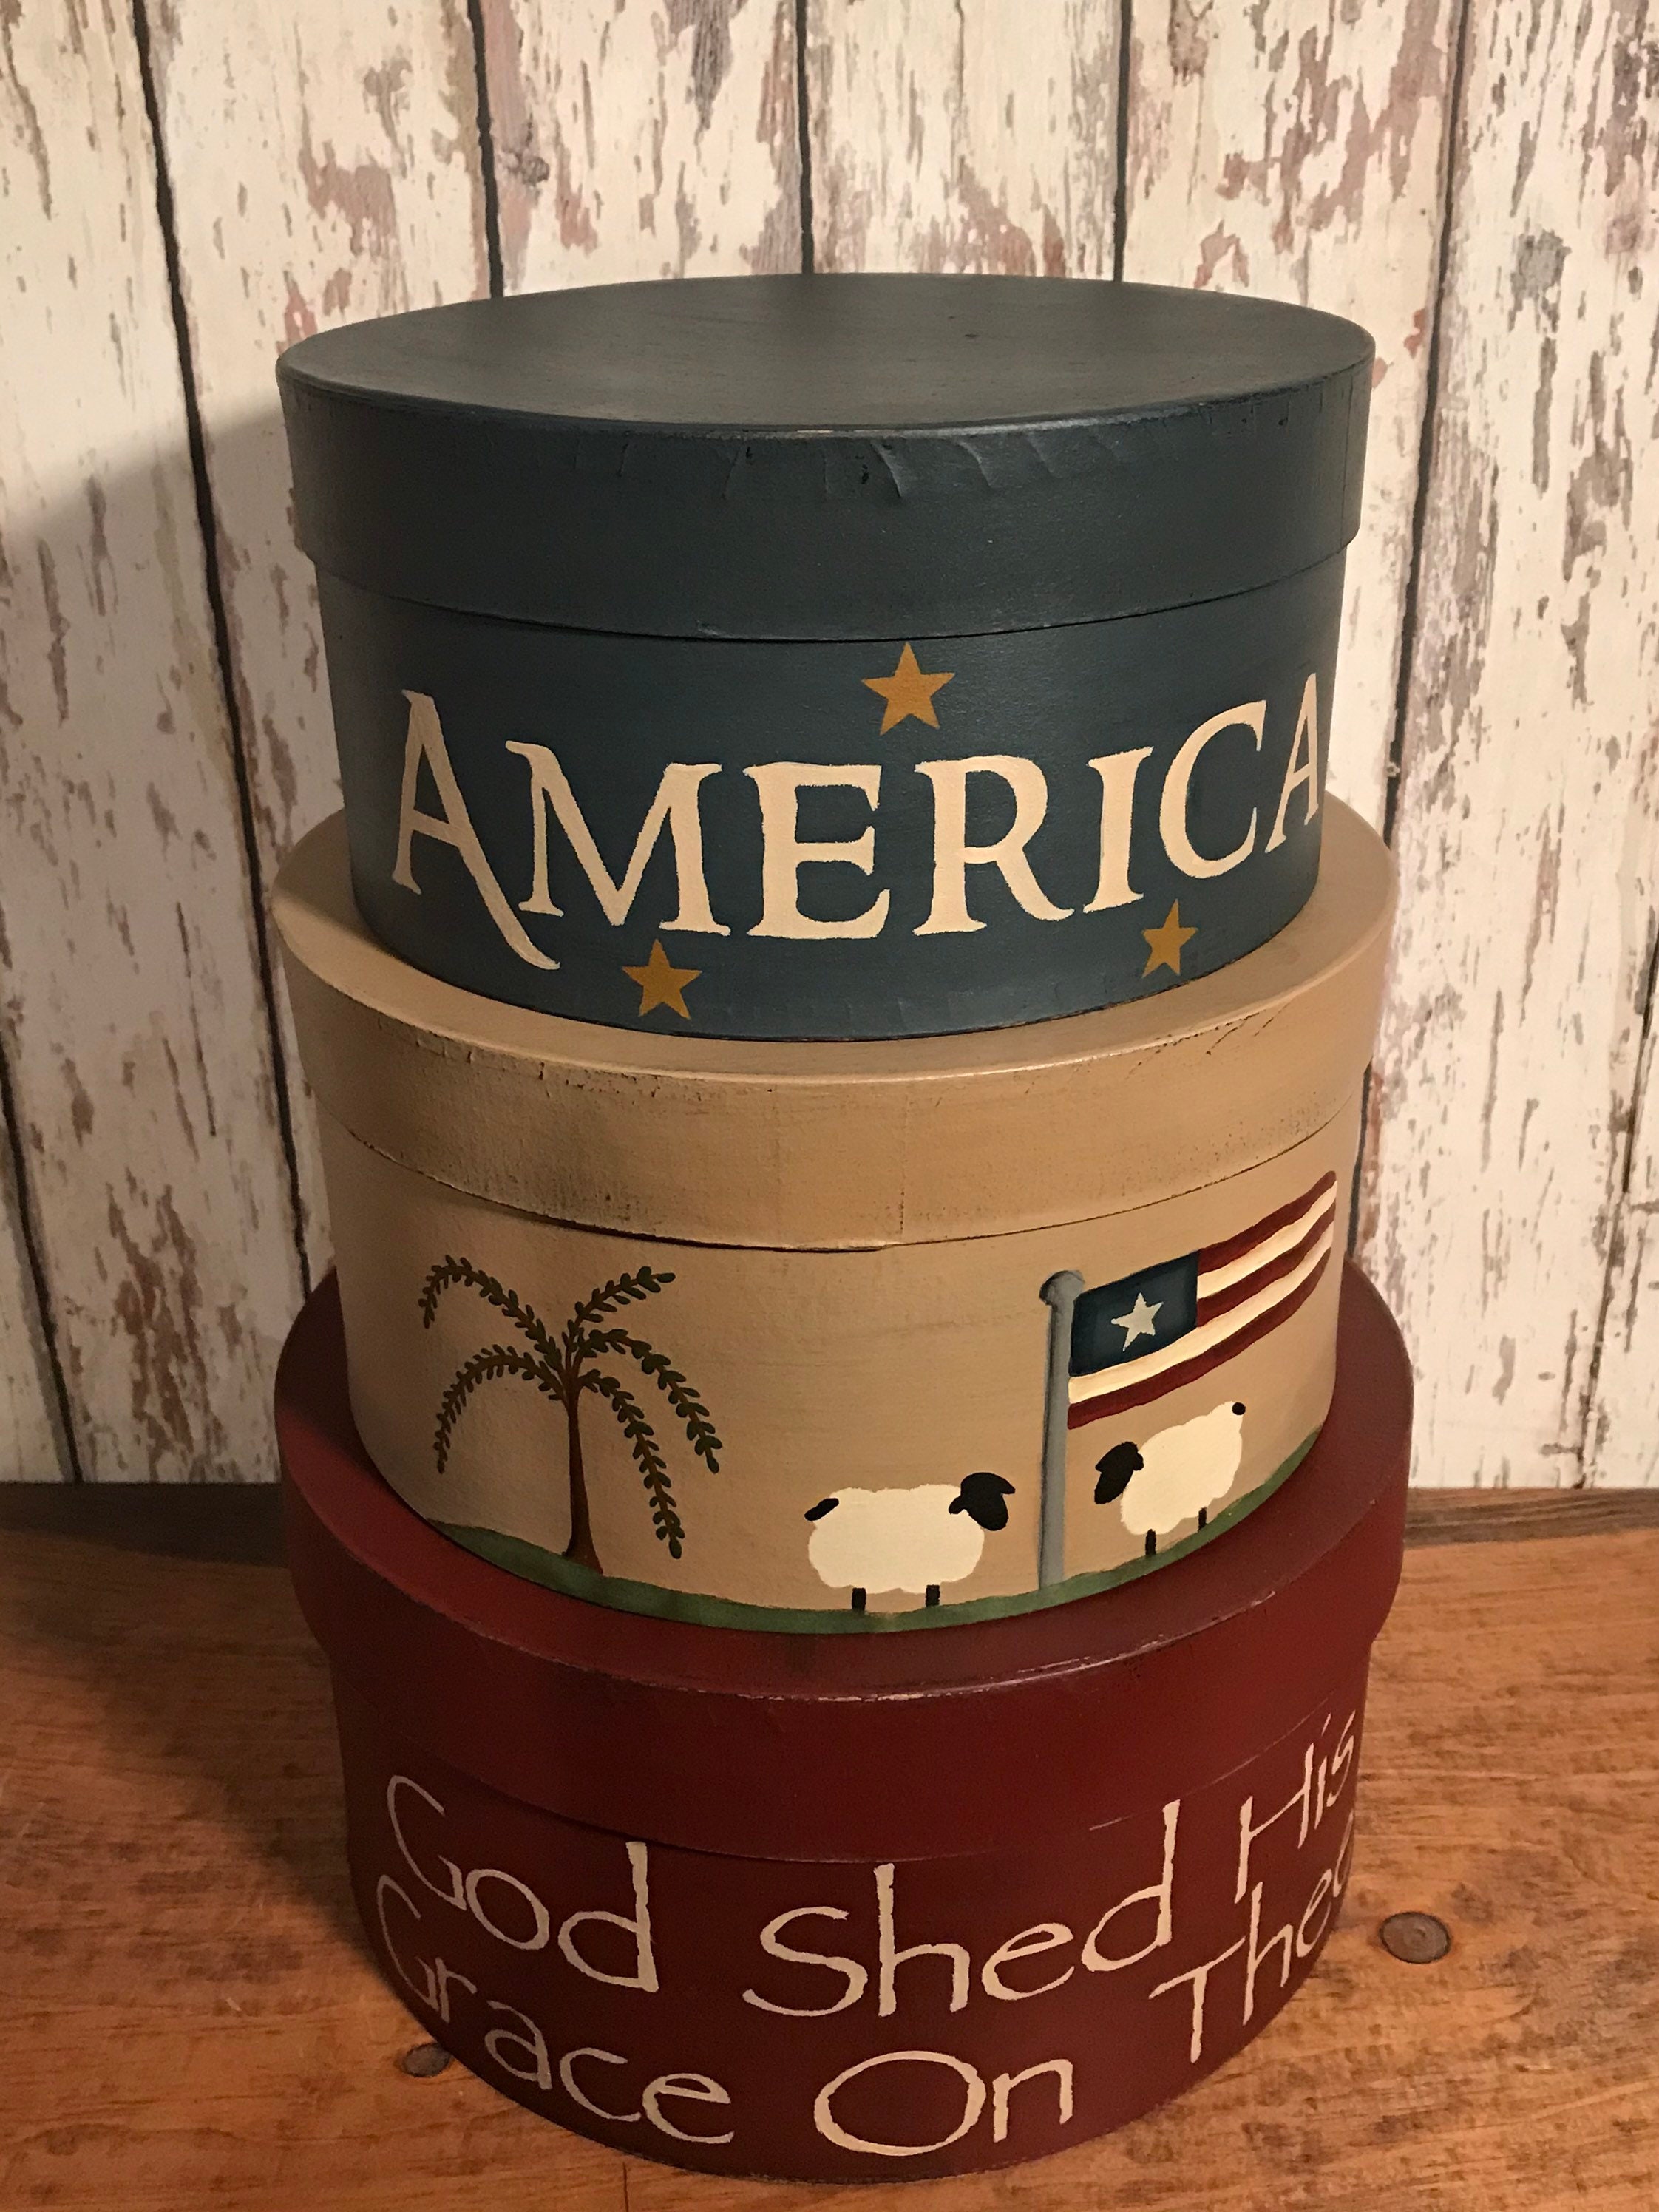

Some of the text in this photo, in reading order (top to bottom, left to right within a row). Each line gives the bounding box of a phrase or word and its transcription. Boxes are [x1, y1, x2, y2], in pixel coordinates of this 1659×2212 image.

[391, 671, 1322, 971] AMERICA
[387, 1775, 660, 1992] God
[1234, 1709, 1357, 1905] His
[377, 1875, 734, 2144] Grace
[814, 2050, 1074, 2157] On
